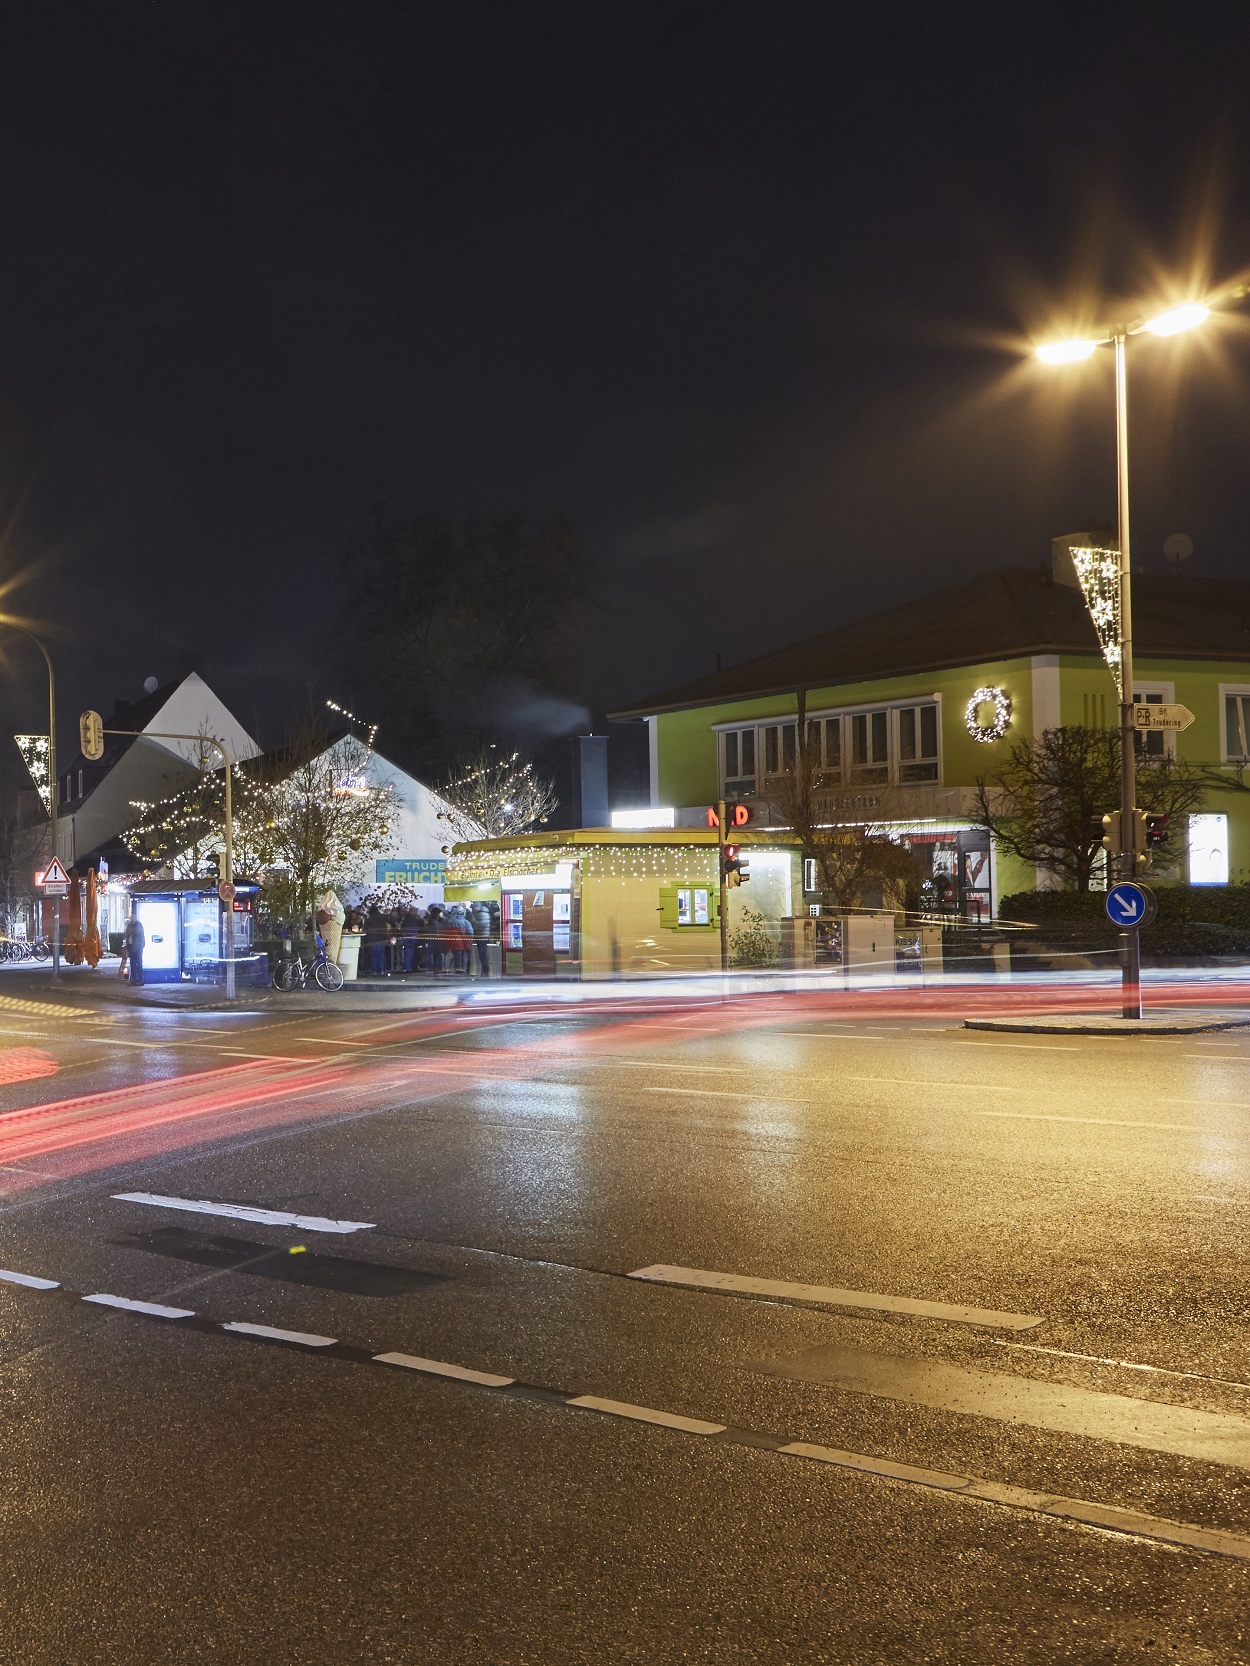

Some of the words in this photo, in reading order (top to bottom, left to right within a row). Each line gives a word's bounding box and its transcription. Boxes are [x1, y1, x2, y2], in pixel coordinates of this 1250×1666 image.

[1137, 711, 1150, 724] P+R
[1153, 718, 1181, 728] Trudering
[707, 805, 749, 827] ND
[896, 938, 921, 946] KISSIN
